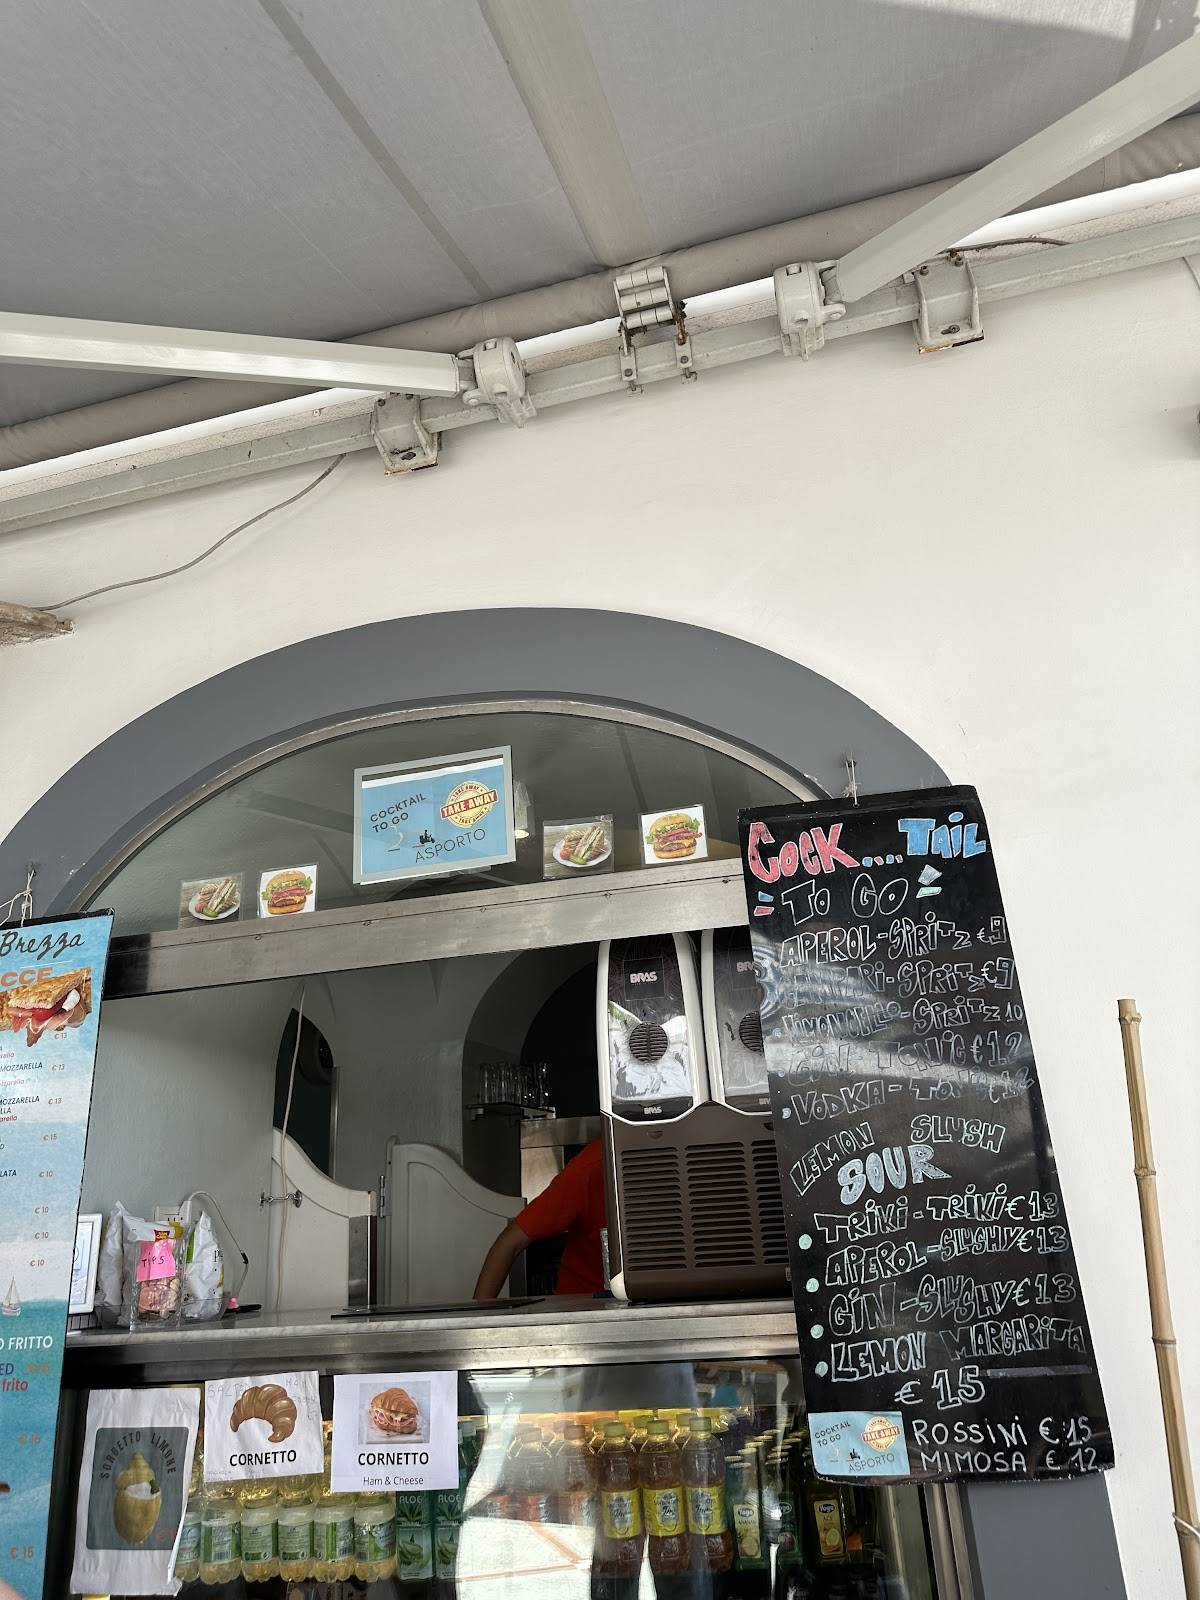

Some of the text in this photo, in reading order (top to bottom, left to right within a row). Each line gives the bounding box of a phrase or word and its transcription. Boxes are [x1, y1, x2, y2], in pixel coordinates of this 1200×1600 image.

[370, 793, 427, 822] COCKTAIL
[442, 791, 496, 817] TAKE AWAY
[372, 812, 409, 833] TO GO
[415, 828, 486, 863] ASPORTO
[781, 873, 908, 926] TO GO
[0, 931, 85, 960] Brezza
[630, 971, 658, 984] BRAS
[1005, 1002, 1023, 1022] 10
[643, 1105, 662, 1115] BRAS
[790, 1115, 1006, 1196] LEMON SLUSH
[837, 1144, 952, 1205] SOUR
[8, 1336, 53, 1350] FRITTO
[830, 1330, 927, 1383] LEMON
[815, 1421, 851, 1439] COCKTAIL
[817, 1433, 841, 1447] TO GO
[99, 1430, 177, 1479] SORBETTO LIMONE
[229, 1450, 297, 1466] CORNETTO
[358, 1452, 429, 1465] CORNETTO
[849, 1453, 895, 1472] ASPORTO
[920, 1451, 1027, 1473] MIMOSA
[363, 1476, 424, 1486] Ham & Cheese
